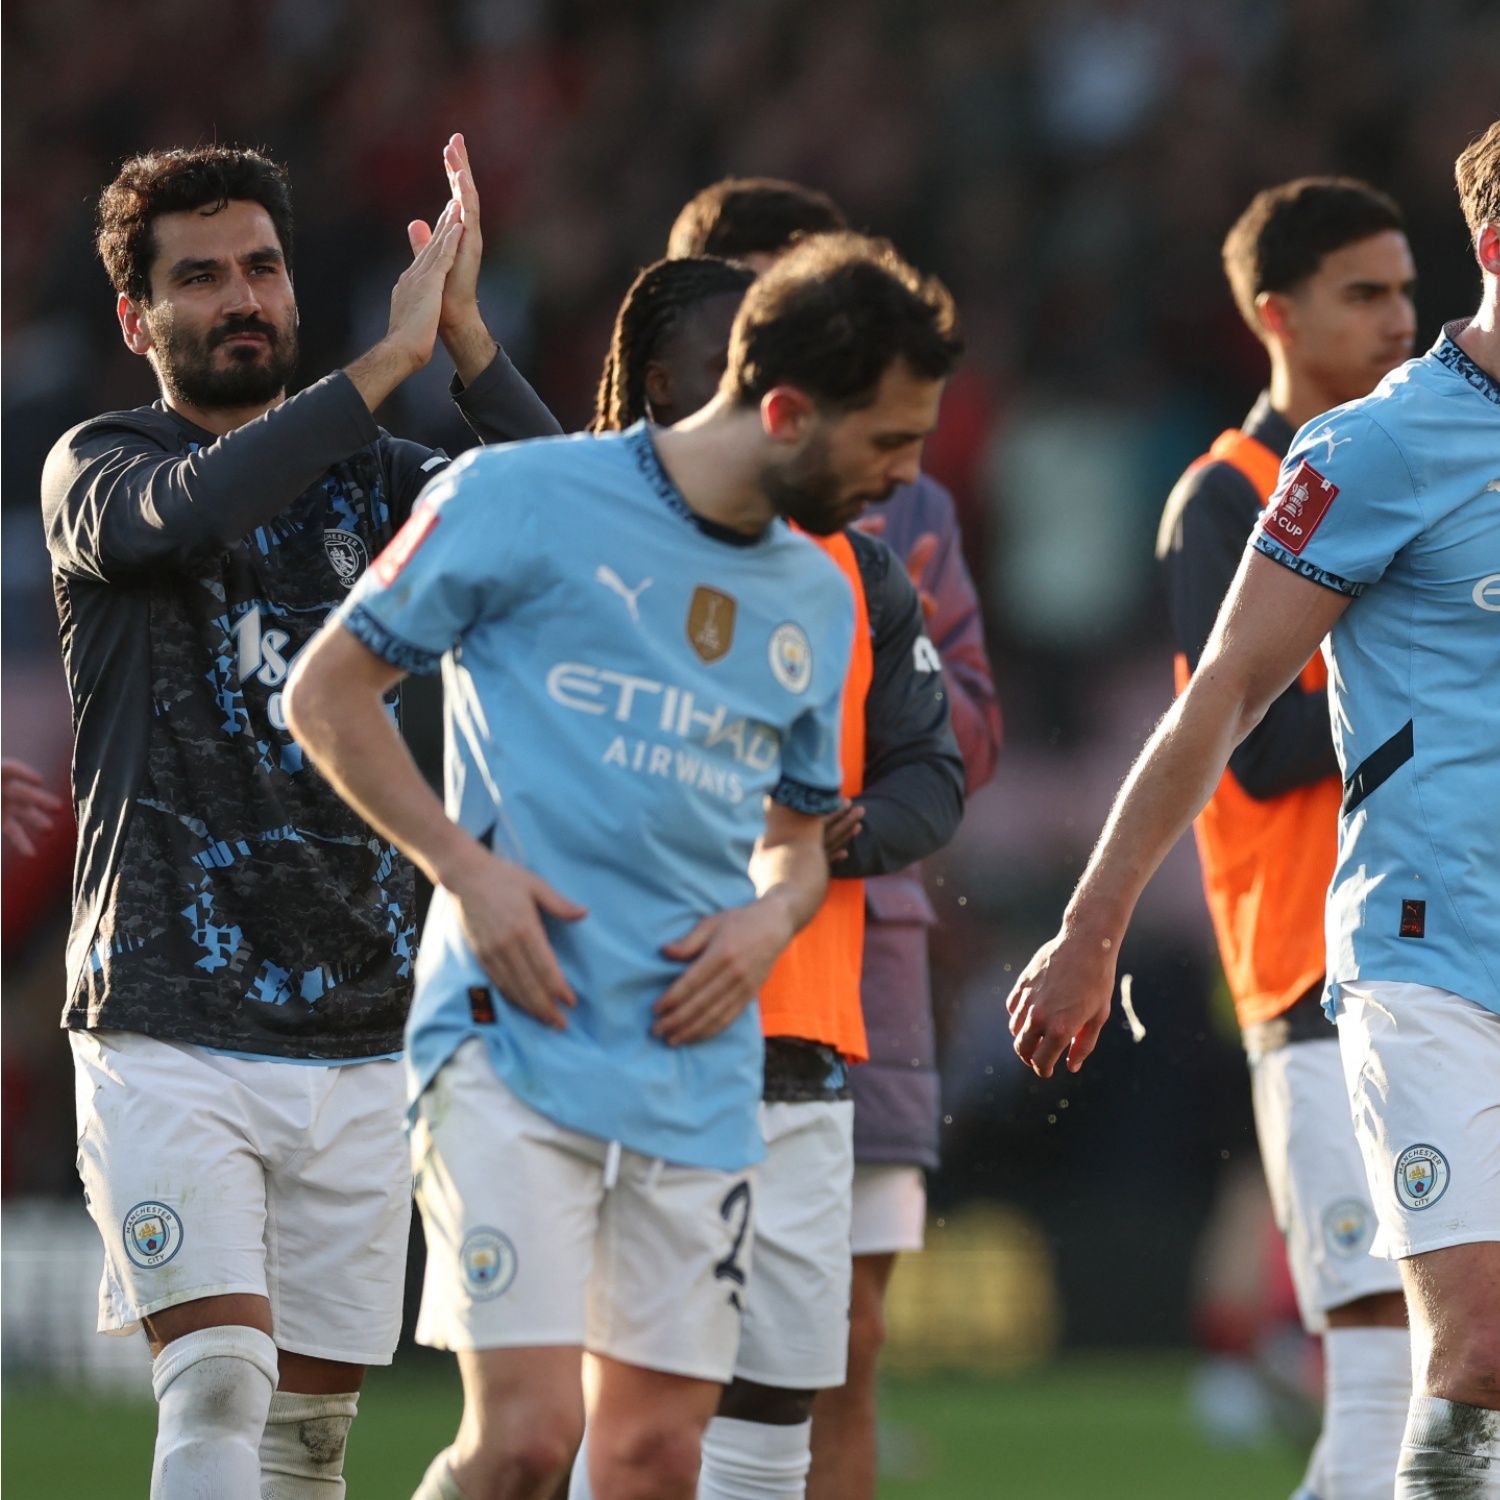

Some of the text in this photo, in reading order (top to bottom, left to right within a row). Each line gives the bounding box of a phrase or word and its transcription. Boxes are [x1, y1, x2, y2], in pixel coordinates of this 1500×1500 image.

[1278, 515, 1304, 537] CUP
[546, 662, 780, 771] ETIHAD
[602, 735, 744, 804] AIRWAYS
[1399, 1149, 1441, 1174] MANCHESTER
[1414, 1198, 1429, 1206] CITY
[126, 1206, 172, 1233] MANCHESTER
[147, 1254, 164, 1264] CITY
